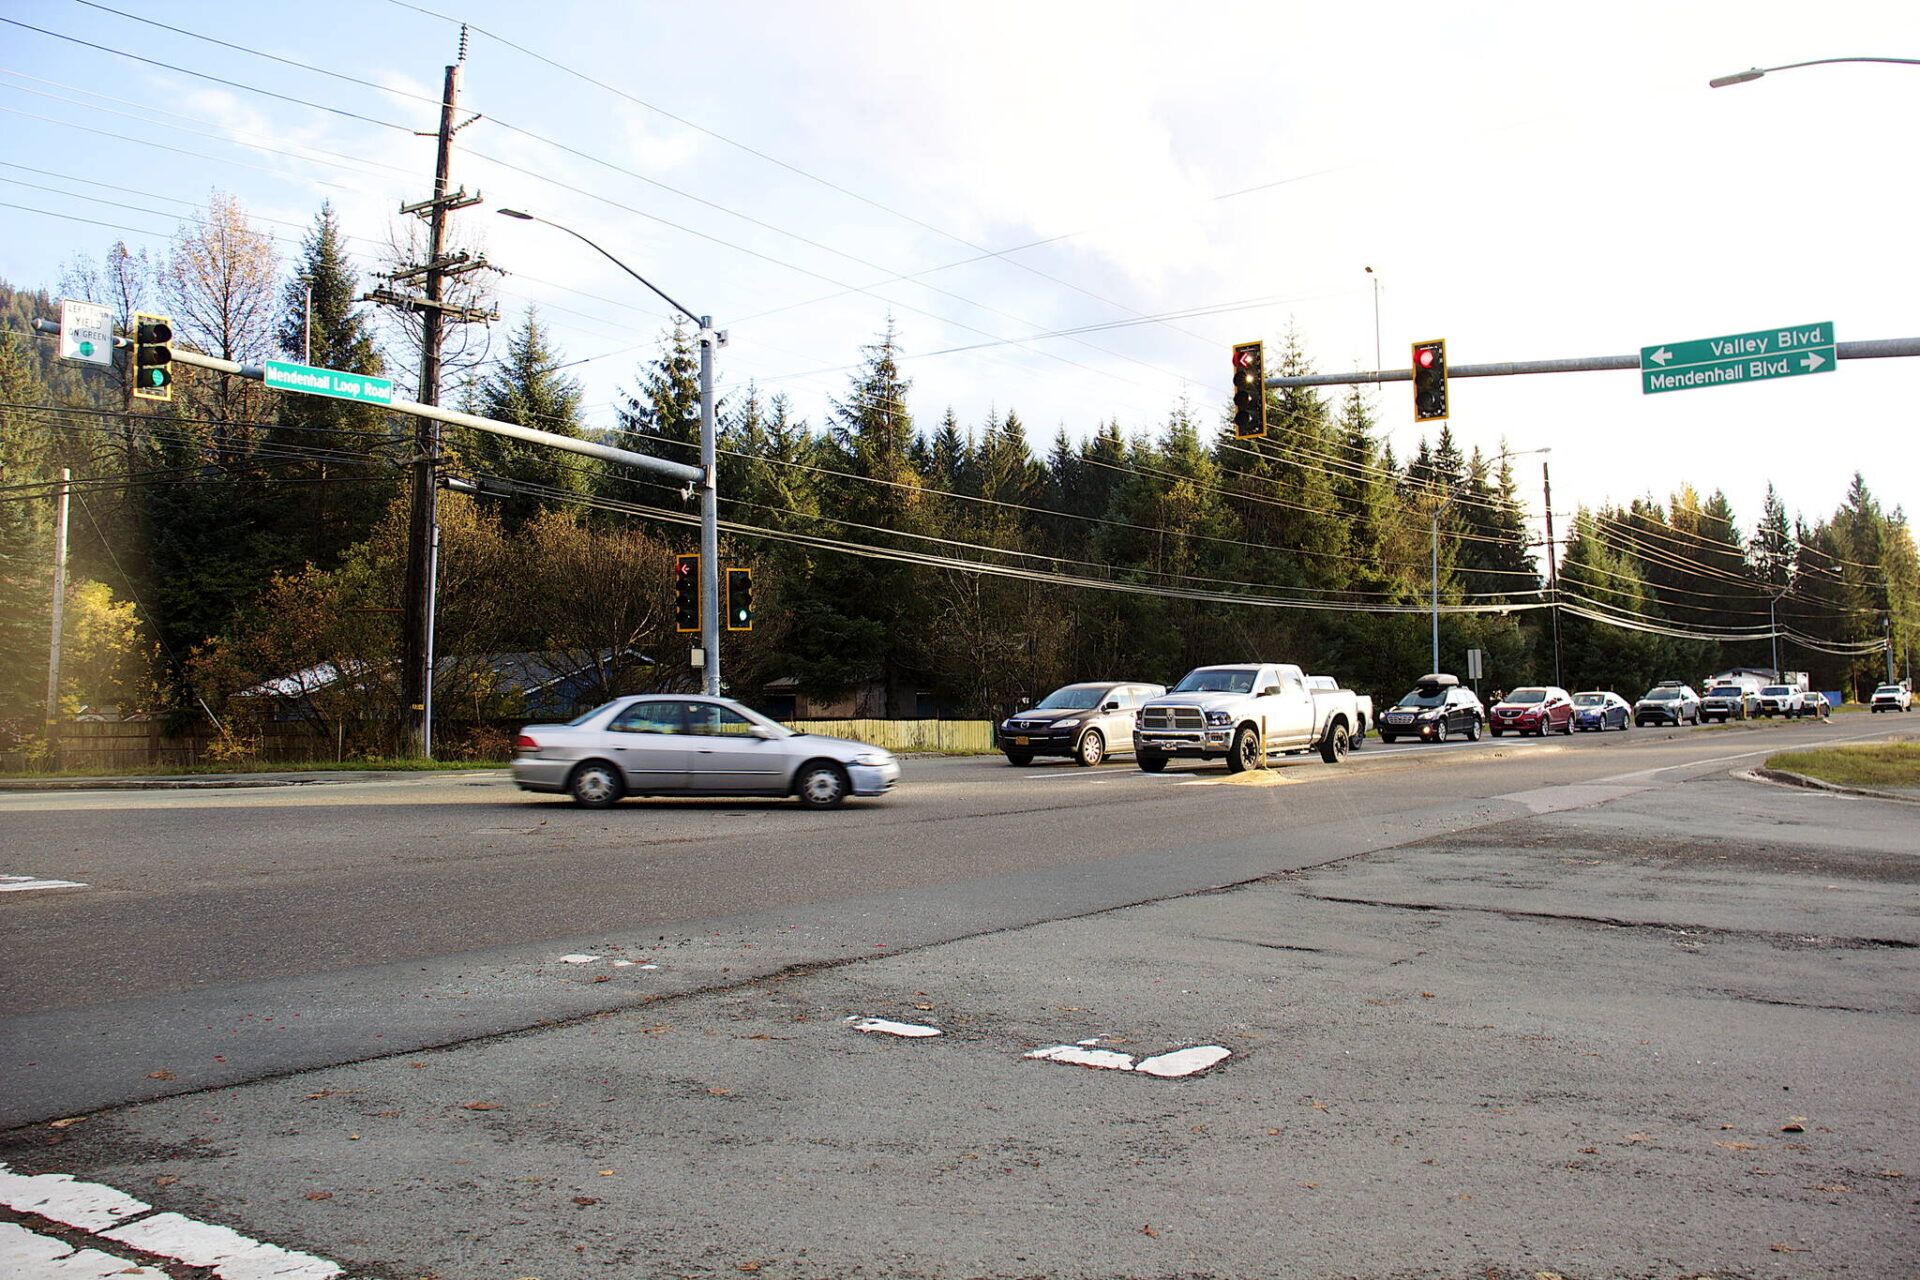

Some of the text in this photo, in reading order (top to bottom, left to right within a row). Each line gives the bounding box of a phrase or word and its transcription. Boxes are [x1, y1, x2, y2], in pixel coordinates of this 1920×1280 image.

[67, 327, 107, 342] ON GREEN
[75, 316, 102, 330] YIELD
[1710, 327, 1825, 357] Valley Blvd.
[267, 366, 391, 399] Mendenhall Loop Road
[1650, 358, 1791, 390] Mendenhall Blvd.
